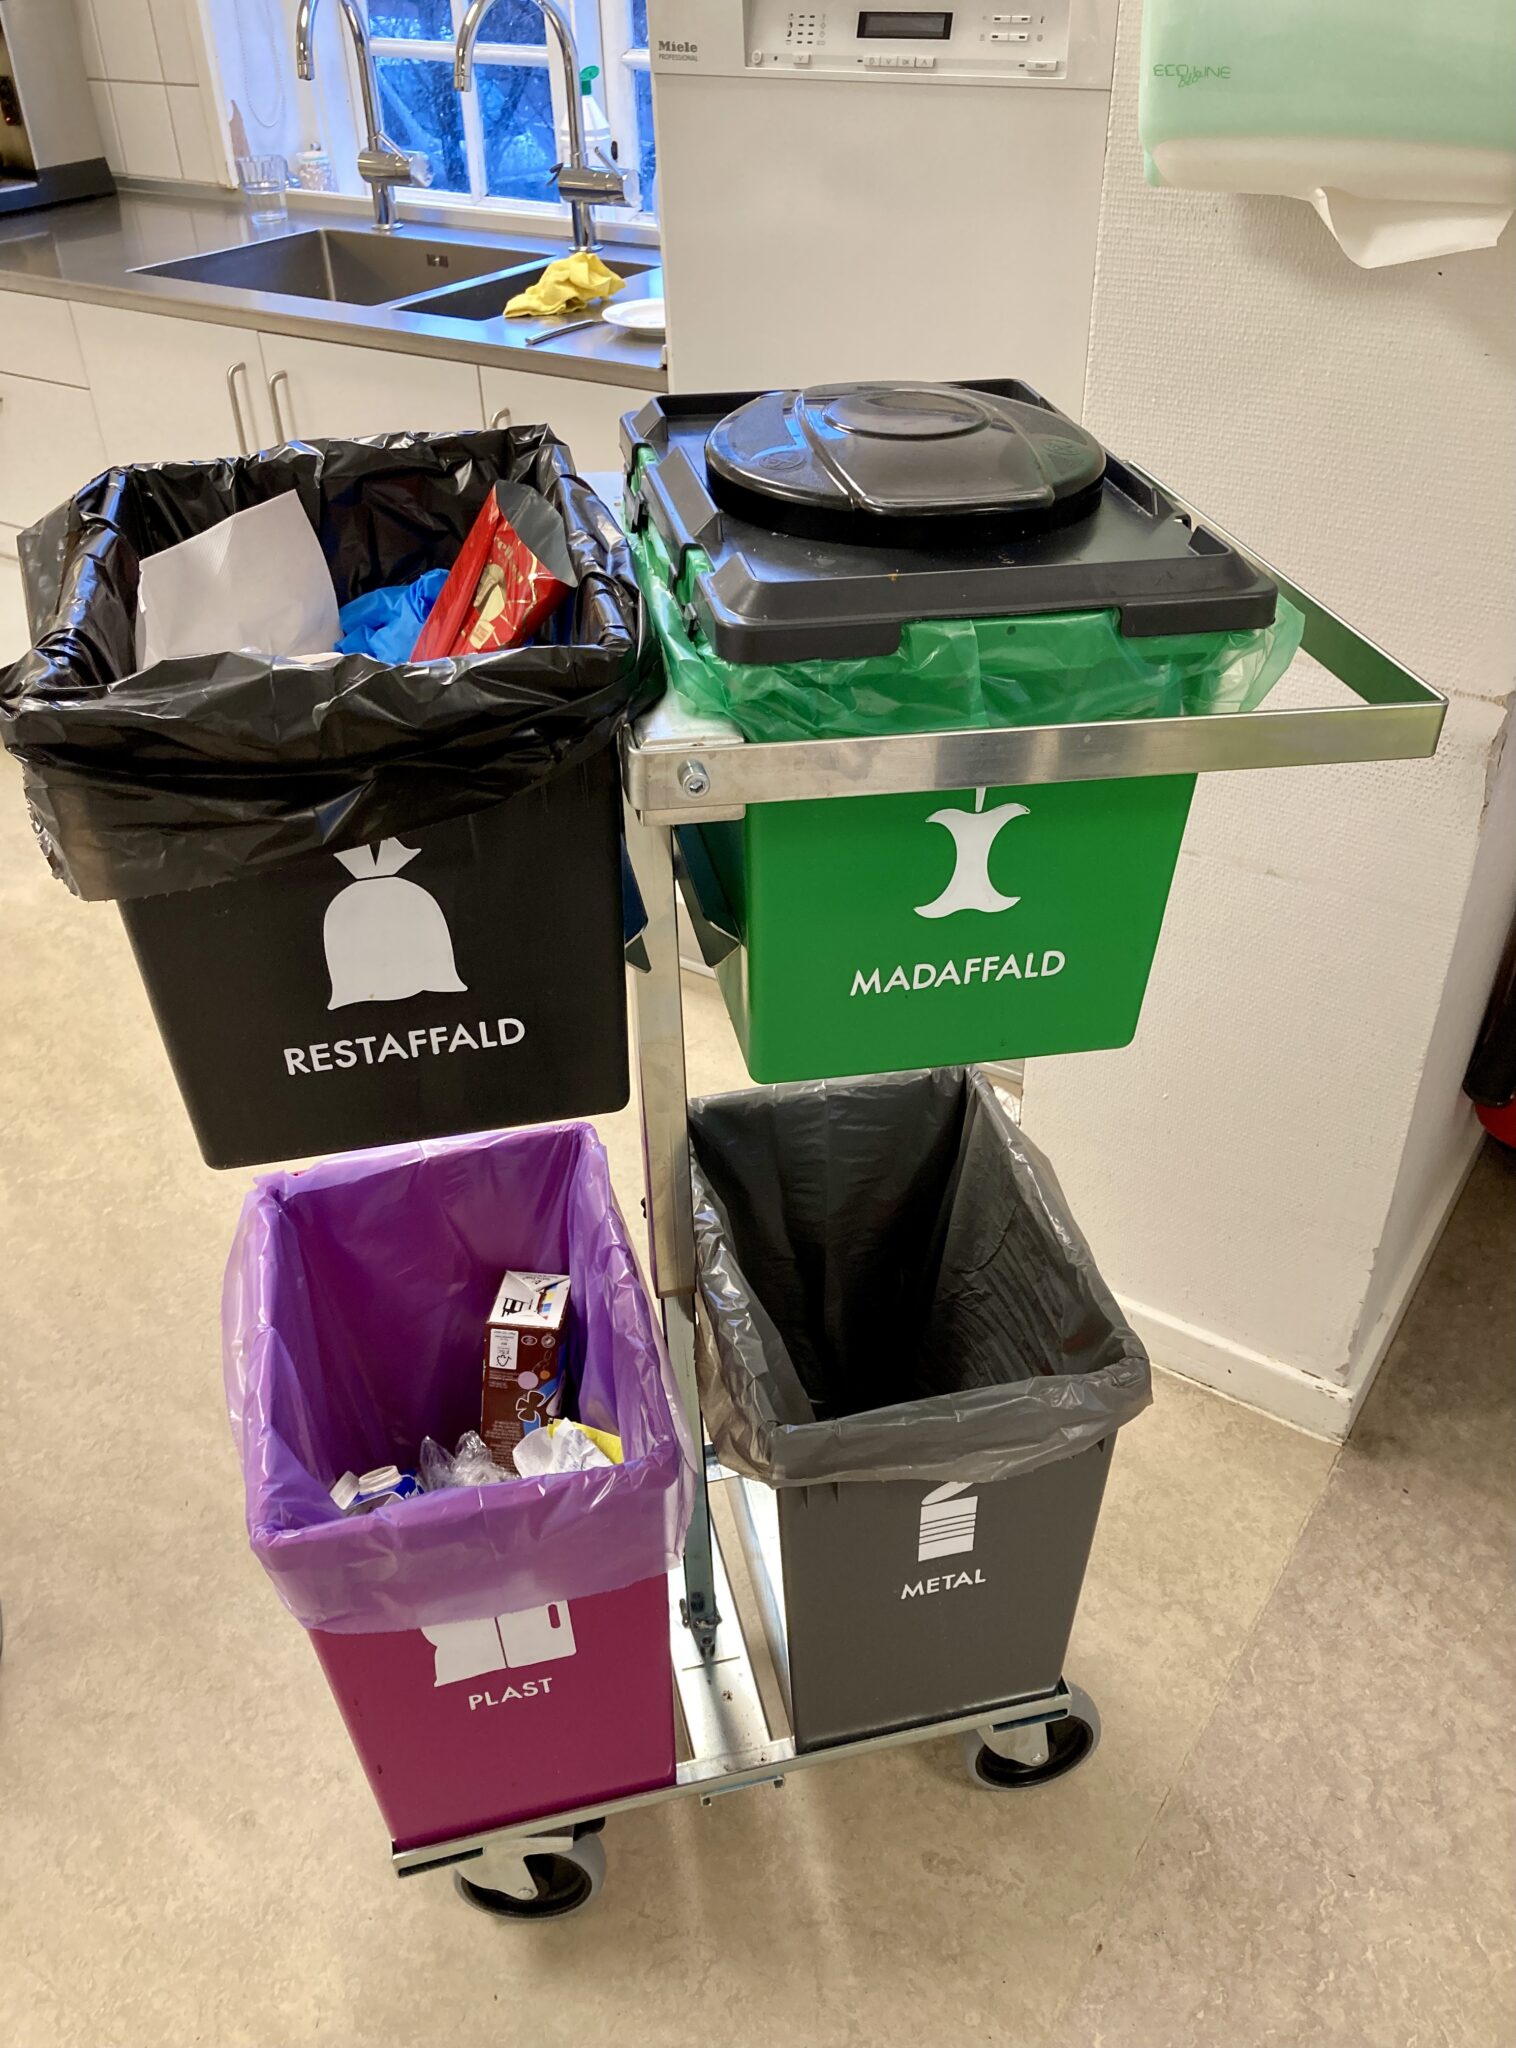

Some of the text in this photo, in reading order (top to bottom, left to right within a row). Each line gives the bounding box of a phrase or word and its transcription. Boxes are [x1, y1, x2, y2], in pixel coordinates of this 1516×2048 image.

[658, 40, 698, 52] Miele
[850, 950, 1066, 996] MADAFFALD
[283, 1017, 526, 1076] RESTAFFALD
[901, 1568, 987, 1600] METAL
[468, 1677, 553, 1711] PLAST
